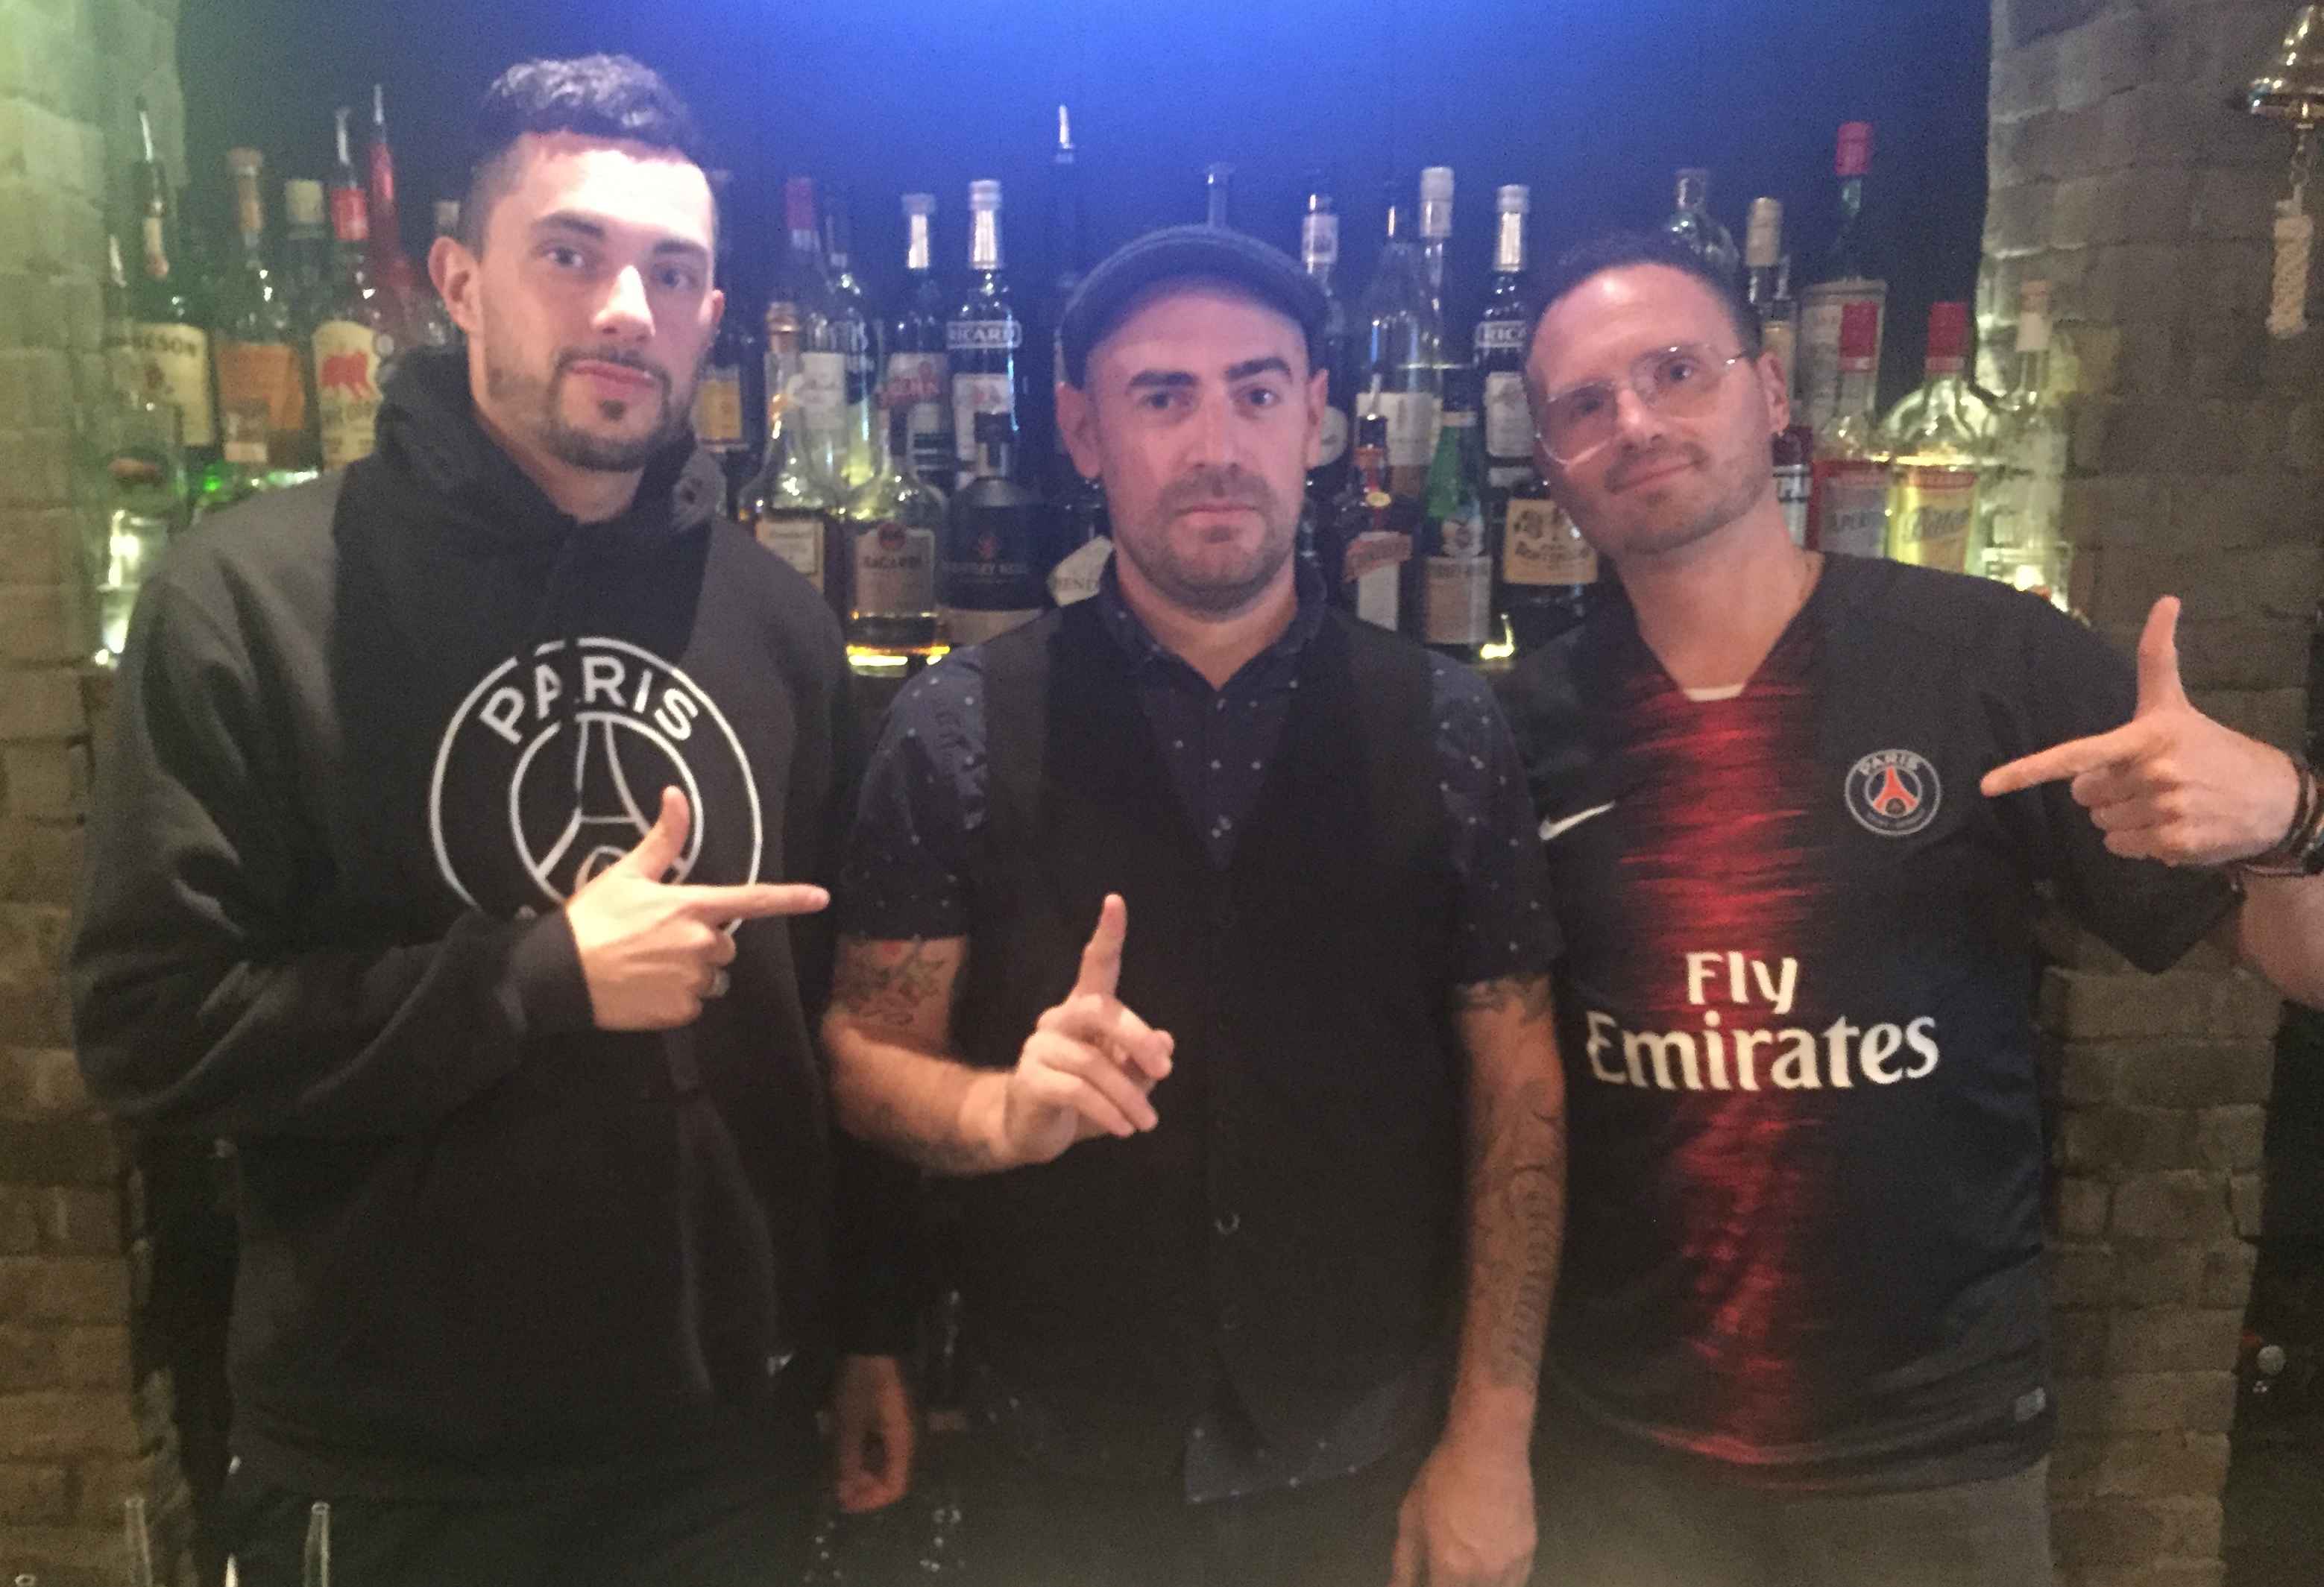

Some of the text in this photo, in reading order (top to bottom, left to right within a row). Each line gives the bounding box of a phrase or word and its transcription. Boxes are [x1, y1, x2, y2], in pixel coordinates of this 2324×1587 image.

[478, 655, 699, 745] PARIS
[1858, 752, 1920, 776] PARIS
[1685, 951, 1798, 1014] Fly
[1587, 1011, 1939, 1091] Emirates
